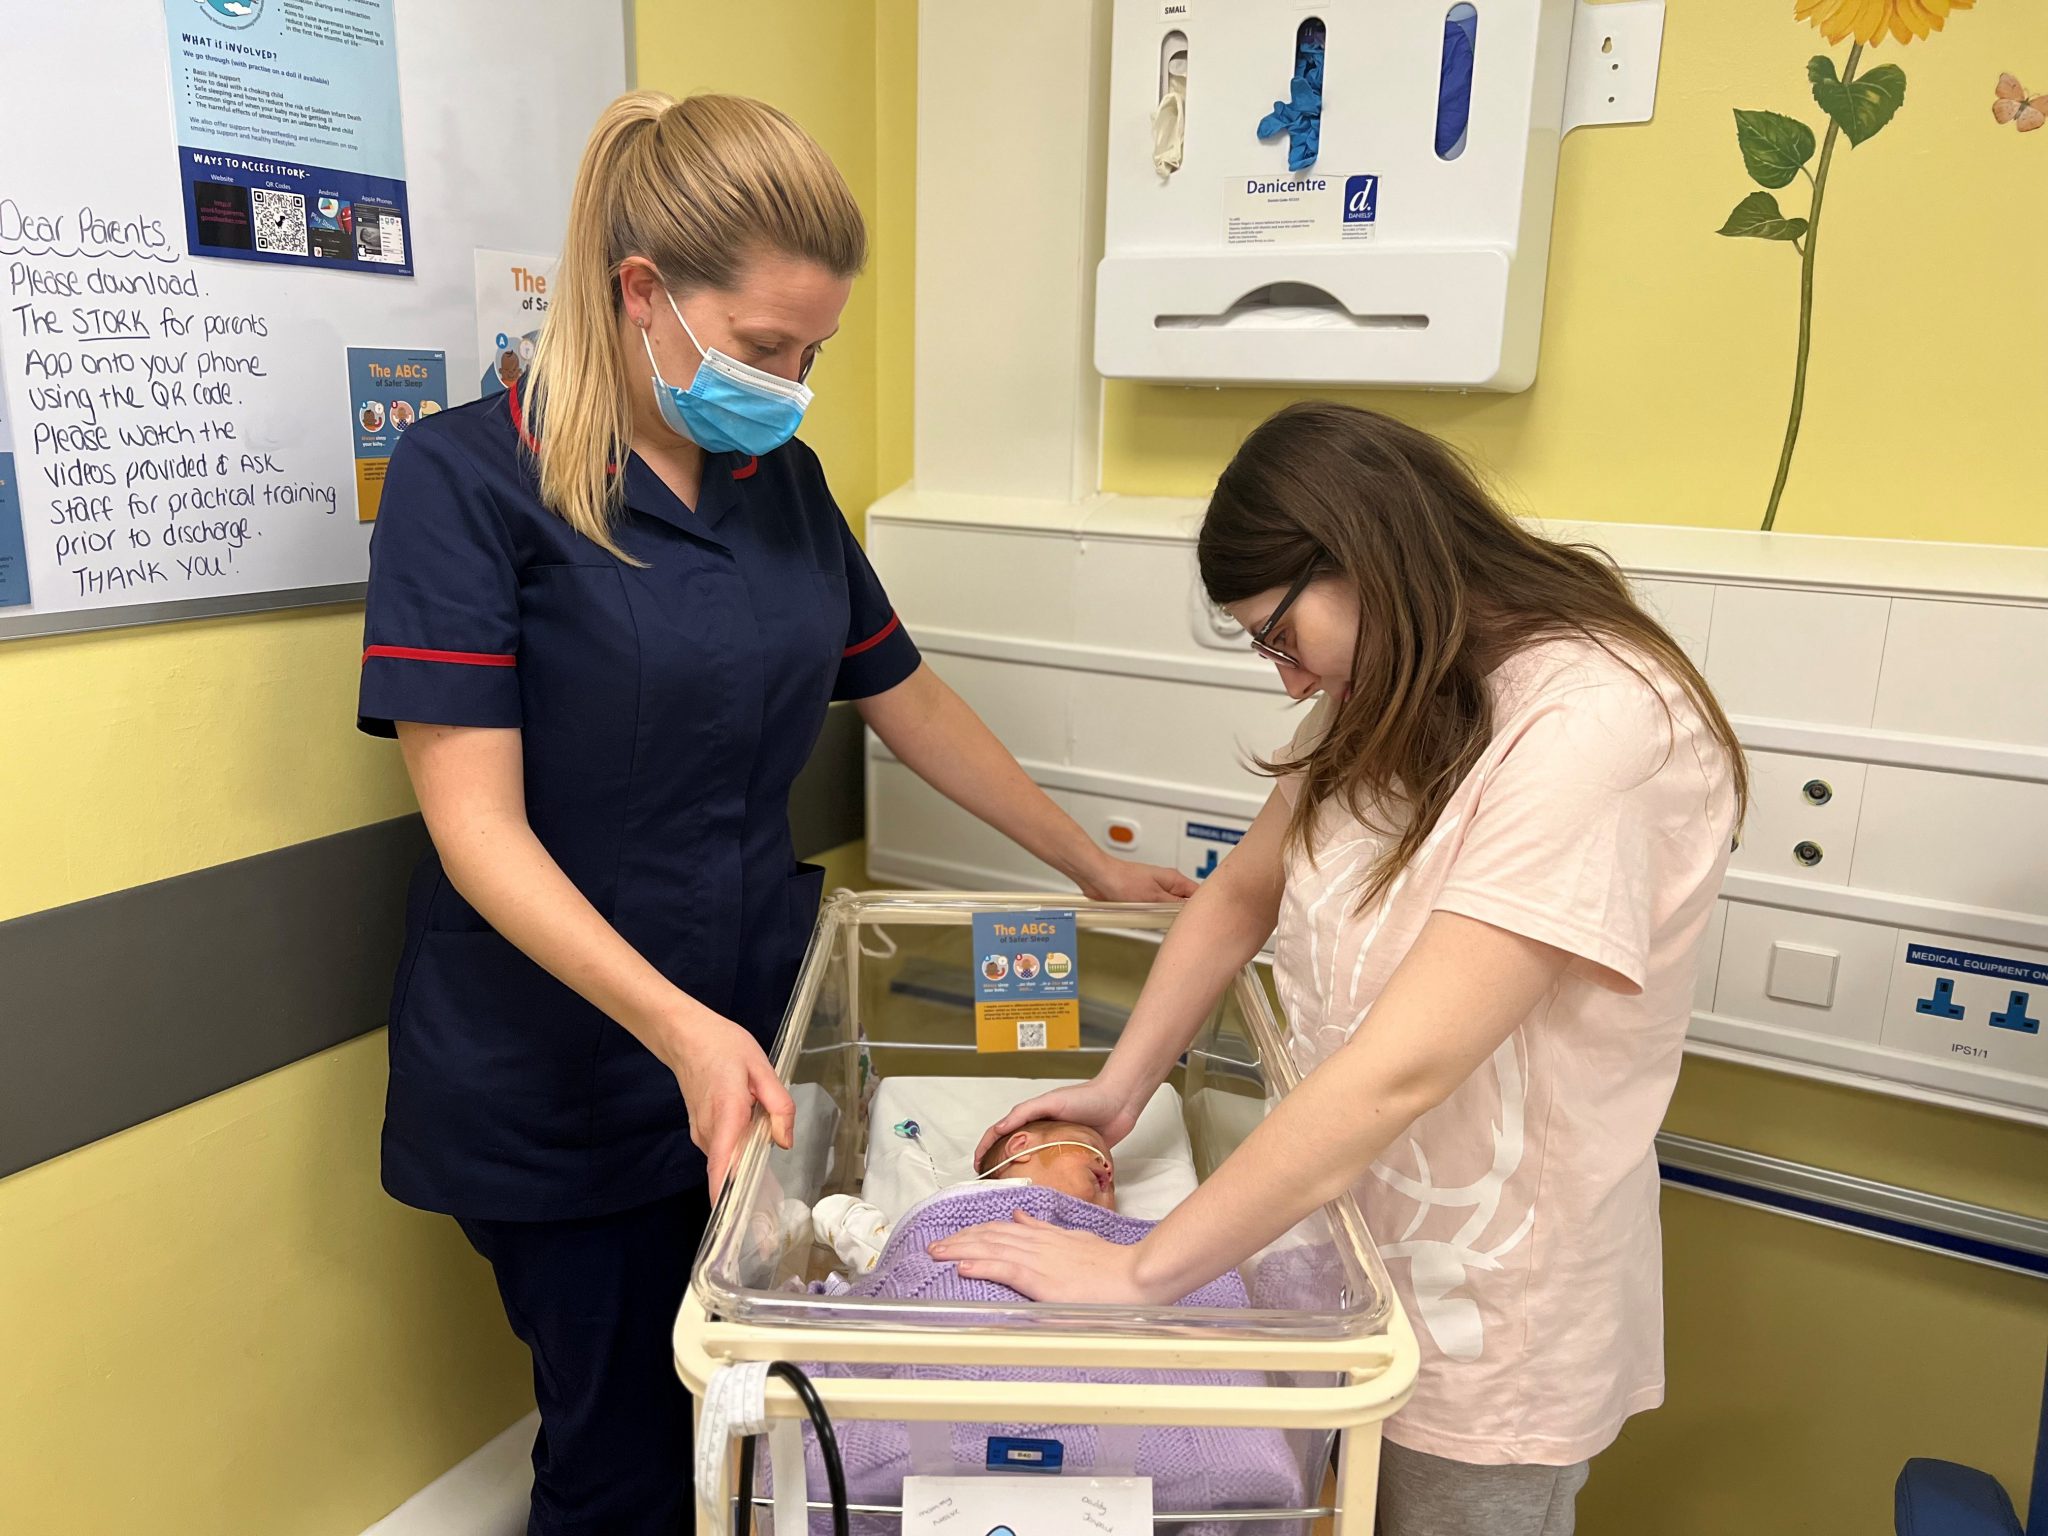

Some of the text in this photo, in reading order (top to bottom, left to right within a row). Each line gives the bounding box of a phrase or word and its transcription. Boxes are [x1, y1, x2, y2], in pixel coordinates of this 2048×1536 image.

[1164, 5, 1187, 14] SMALL
[182, 33, 212, 48] WHAT
[205, 54, 230, 65] through
[232, 58, 248, 68] (with
[286, 70, 296, 78] doll
[303, 75, 330, 86] available)
[219, 74, 241, 84] support
[208, 88, 232, 98] sleeping
[266, 98, 284, 106] reduce
[311, 106, 330, 116] Sudden
[248, 88, 270, 97] choking
[271, 91, 284, 99] child
[195, 93, 221, 102] Common
[222, 98, 236, 106] signs
[308, 114, 327, 124] getting
[196, 100, 207, 108] The
[208, 104, 232, 113] harmful
[232, 108, 250, 116] effects
[259, 114, 282, 123] smoking
[318, 123, 330, 132] baby
[194, 153, 310, 179] WAYS TO ACCESS STORK-
[210, 174, 234, 183] Website
[1247, 178, 1326, 194] Danicentre
[0, 199, 171, 252] Dear Parents,
[311, 212, 336, 230] Play Store
[10, 262, 82, 296] Please
[511, 267, 546, 294] The
[522, 297, 533, 310] of
[12, 303, 268, 342] The STORK for parents
[25, 349, 267, 383] App onto your phone
[368, 364, 428, 378] The ABCs
[99, 385, 144, 409] the
[151, 380, 186, 410] QR
[34, 422, 110, 455] Please
[200, 420, 236, 442] the
[126, 453, 208, 488] provided
[128, 492, 157, 520] for
[169, 484, 256, 520] practical
[263, 482, 337, 514] training
[56, 529, 116, 566] prior
[128, 527, 152, 549] to
[72, 560, 169, 597] THANK
[993, 923, 1056, 936] The ABCs
[1911, 950, 1960, 966] MEDICAL
[1964, 960, 2030, 977] EQUIPMENT
[1951, 1043, 1988, 1059] IPS1/1
